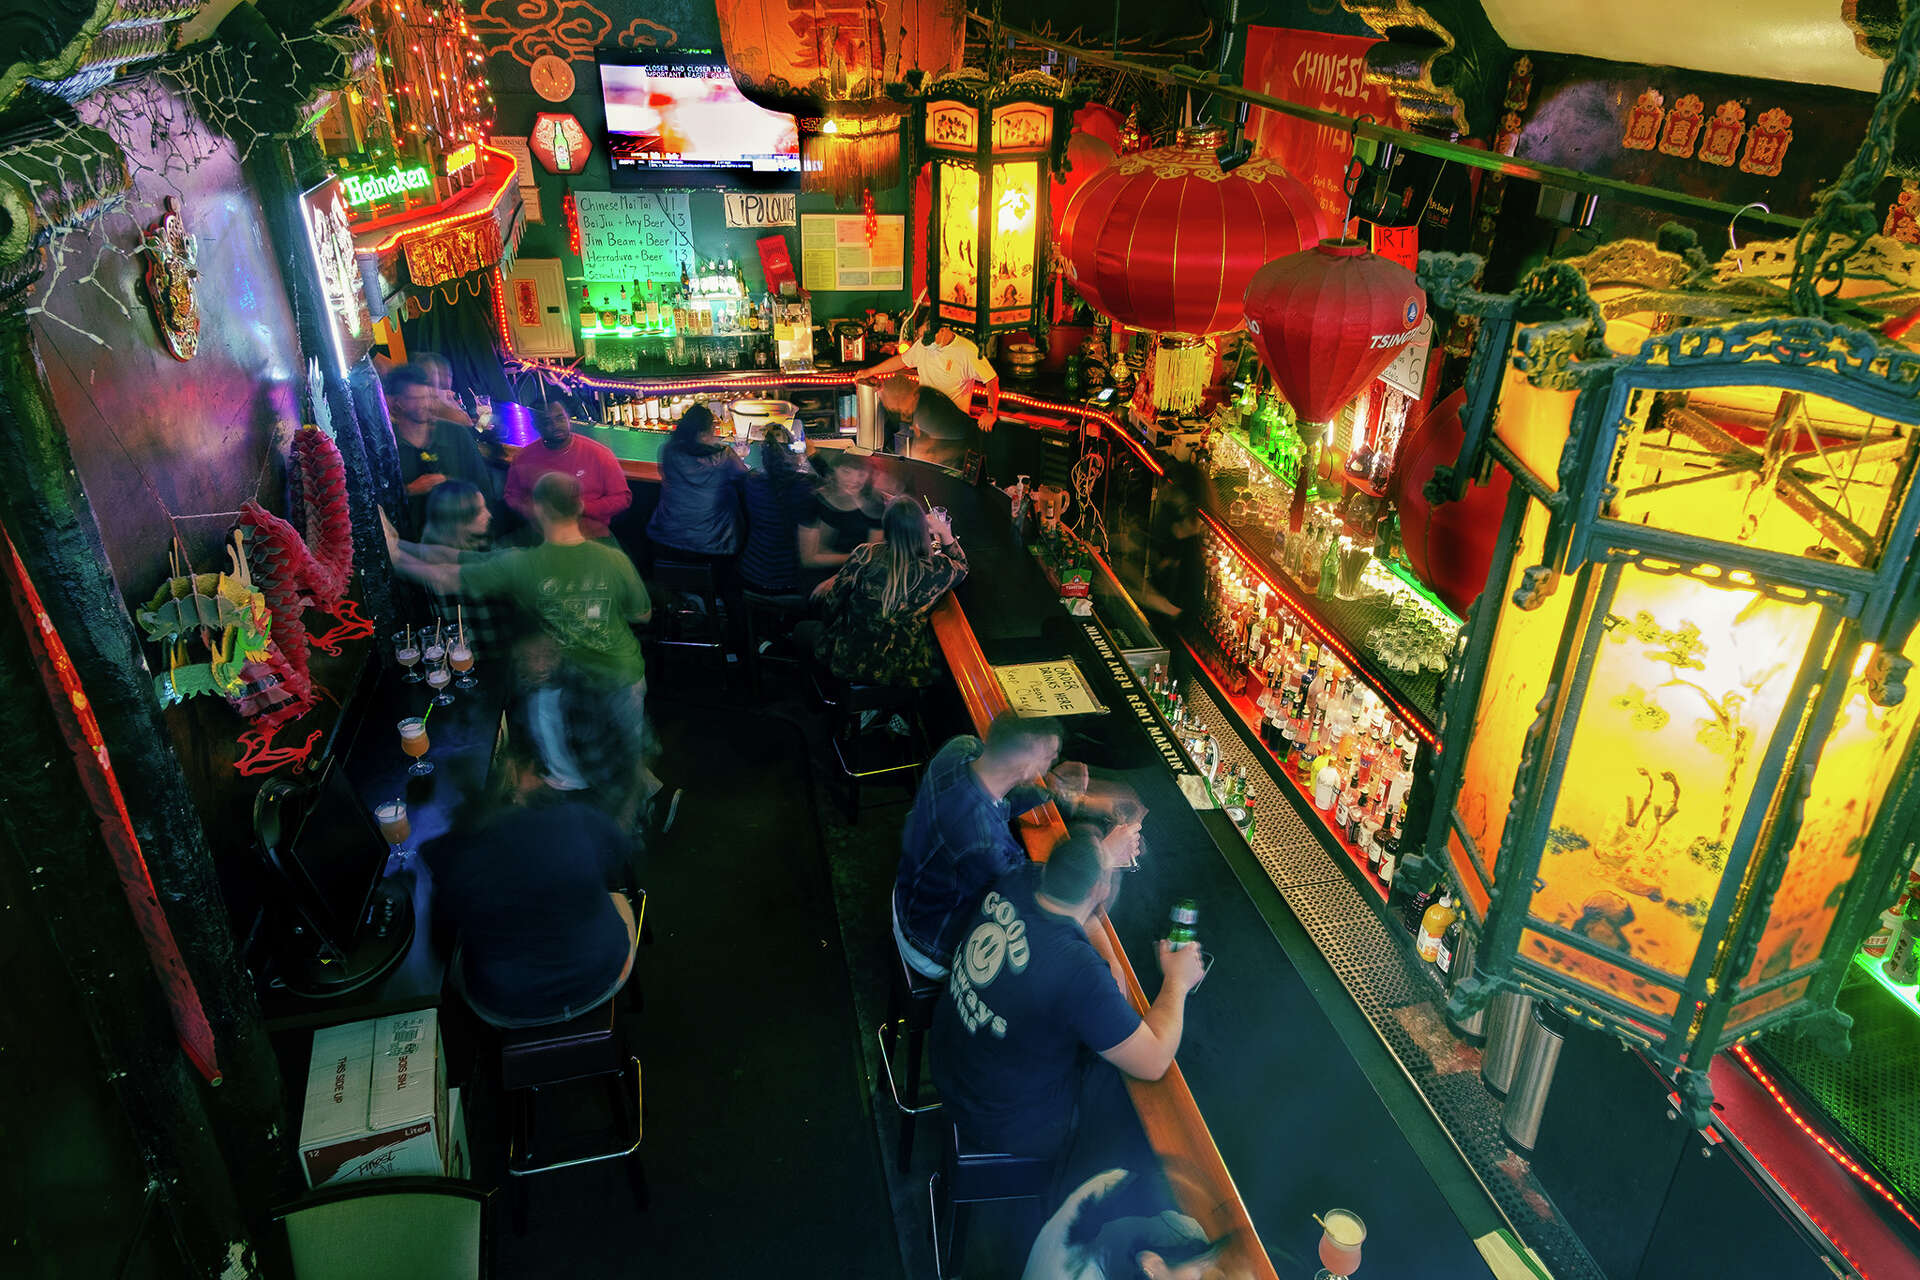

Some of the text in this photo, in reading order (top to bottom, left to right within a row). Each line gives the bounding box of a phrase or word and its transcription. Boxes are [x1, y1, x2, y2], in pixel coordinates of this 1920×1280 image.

[343, 165, 430, 206] Heineken
[580, 197, 618, 212] Chinese
[625, 214, 641, 234] Any
[643, 213, 665, 228] Beer
[585, 232, 603, 247] Jim
[607, 231, 637, 247] Beam
[645, 232, 670, 247] Beer
[641, 249, 663, 262] Beer
[1085, 626, 1116, 660] MARTIN
[1039, 666, 1075, 711] DRINKS HERE
[1054, 666, 1080, 691] ORDER
[1145, 727, 1186, 770] MARTIN
[982, 891, 1030, 968] GOOD
[404, 1125, 427, 1137] Liter
